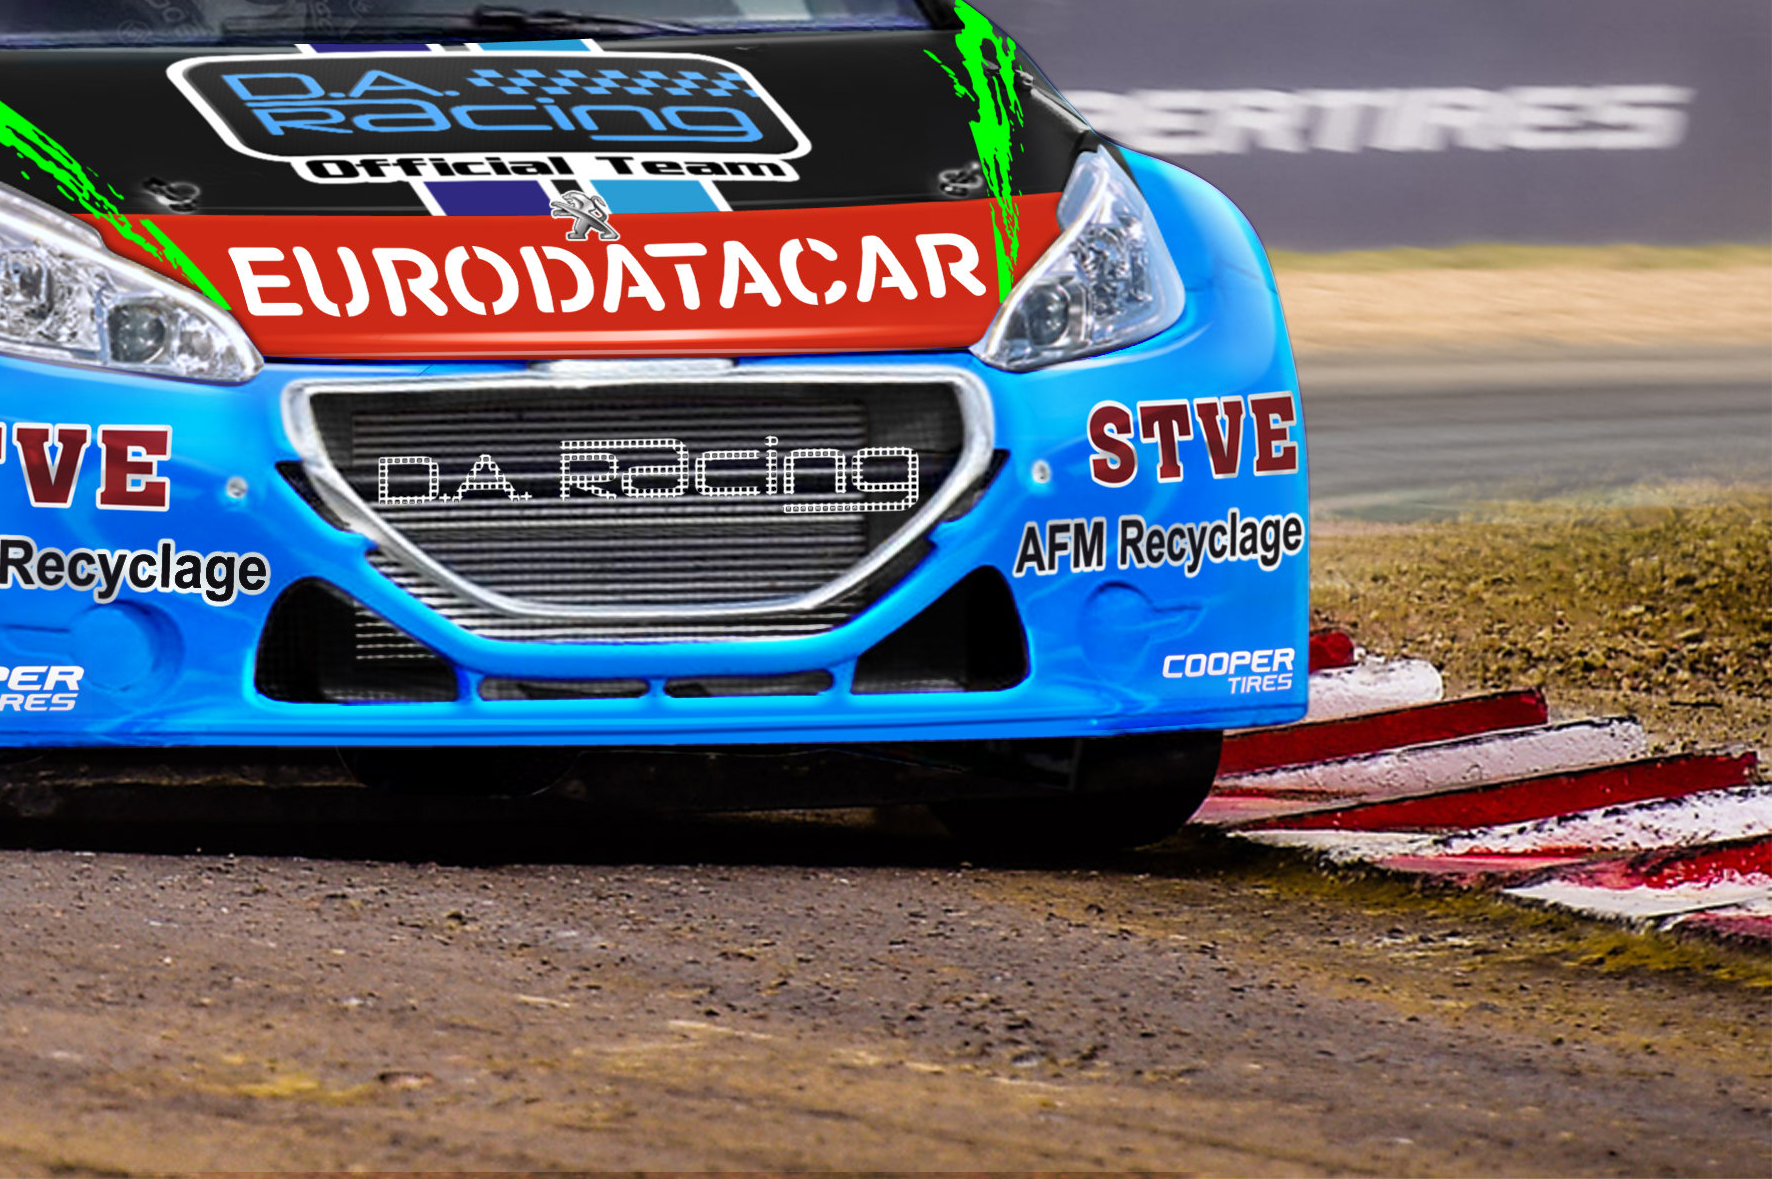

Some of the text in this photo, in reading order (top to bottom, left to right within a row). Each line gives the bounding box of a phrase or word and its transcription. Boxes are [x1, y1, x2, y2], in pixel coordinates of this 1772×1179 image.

[245, 98, 764, 142] Racing
[306, 157, 787, 179] Official Team
[227, 232, 988, 318] EURODATACAR
[1088, 395, 1298, 484] STVE
[560, 435, 920, 513] Racing
[1015, 511, 1302, 574] AFM Recyclage
[1162, 648, 1296, 679] COOPER
[1228, 673, 1293, 694] TIRES
